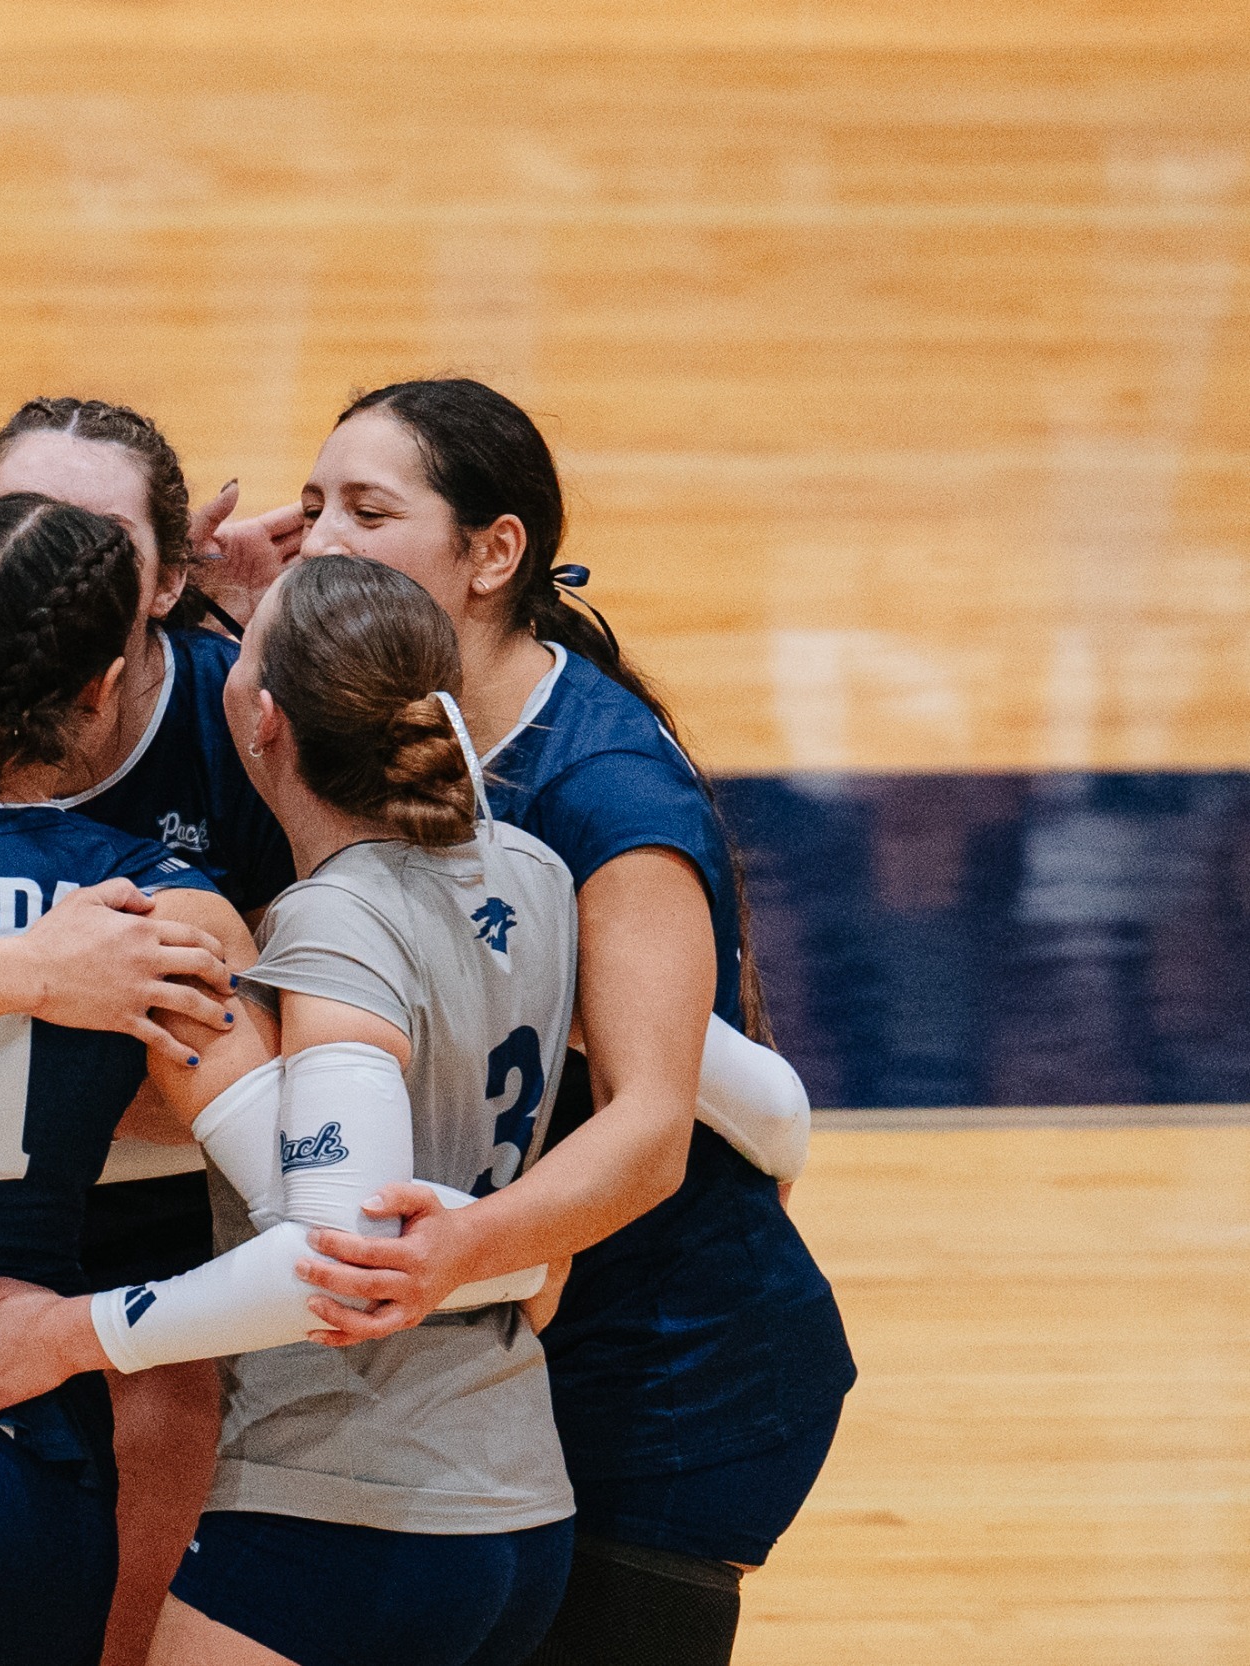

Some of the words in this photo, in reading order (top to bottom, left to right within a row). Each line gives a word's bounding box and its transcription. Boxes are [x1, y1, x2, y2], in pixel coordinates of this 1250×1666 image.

[158, 812, 210, 852] Pack
[468, 1024, 545, 1199] 3
[280, 1121, 349, 1177] ack
